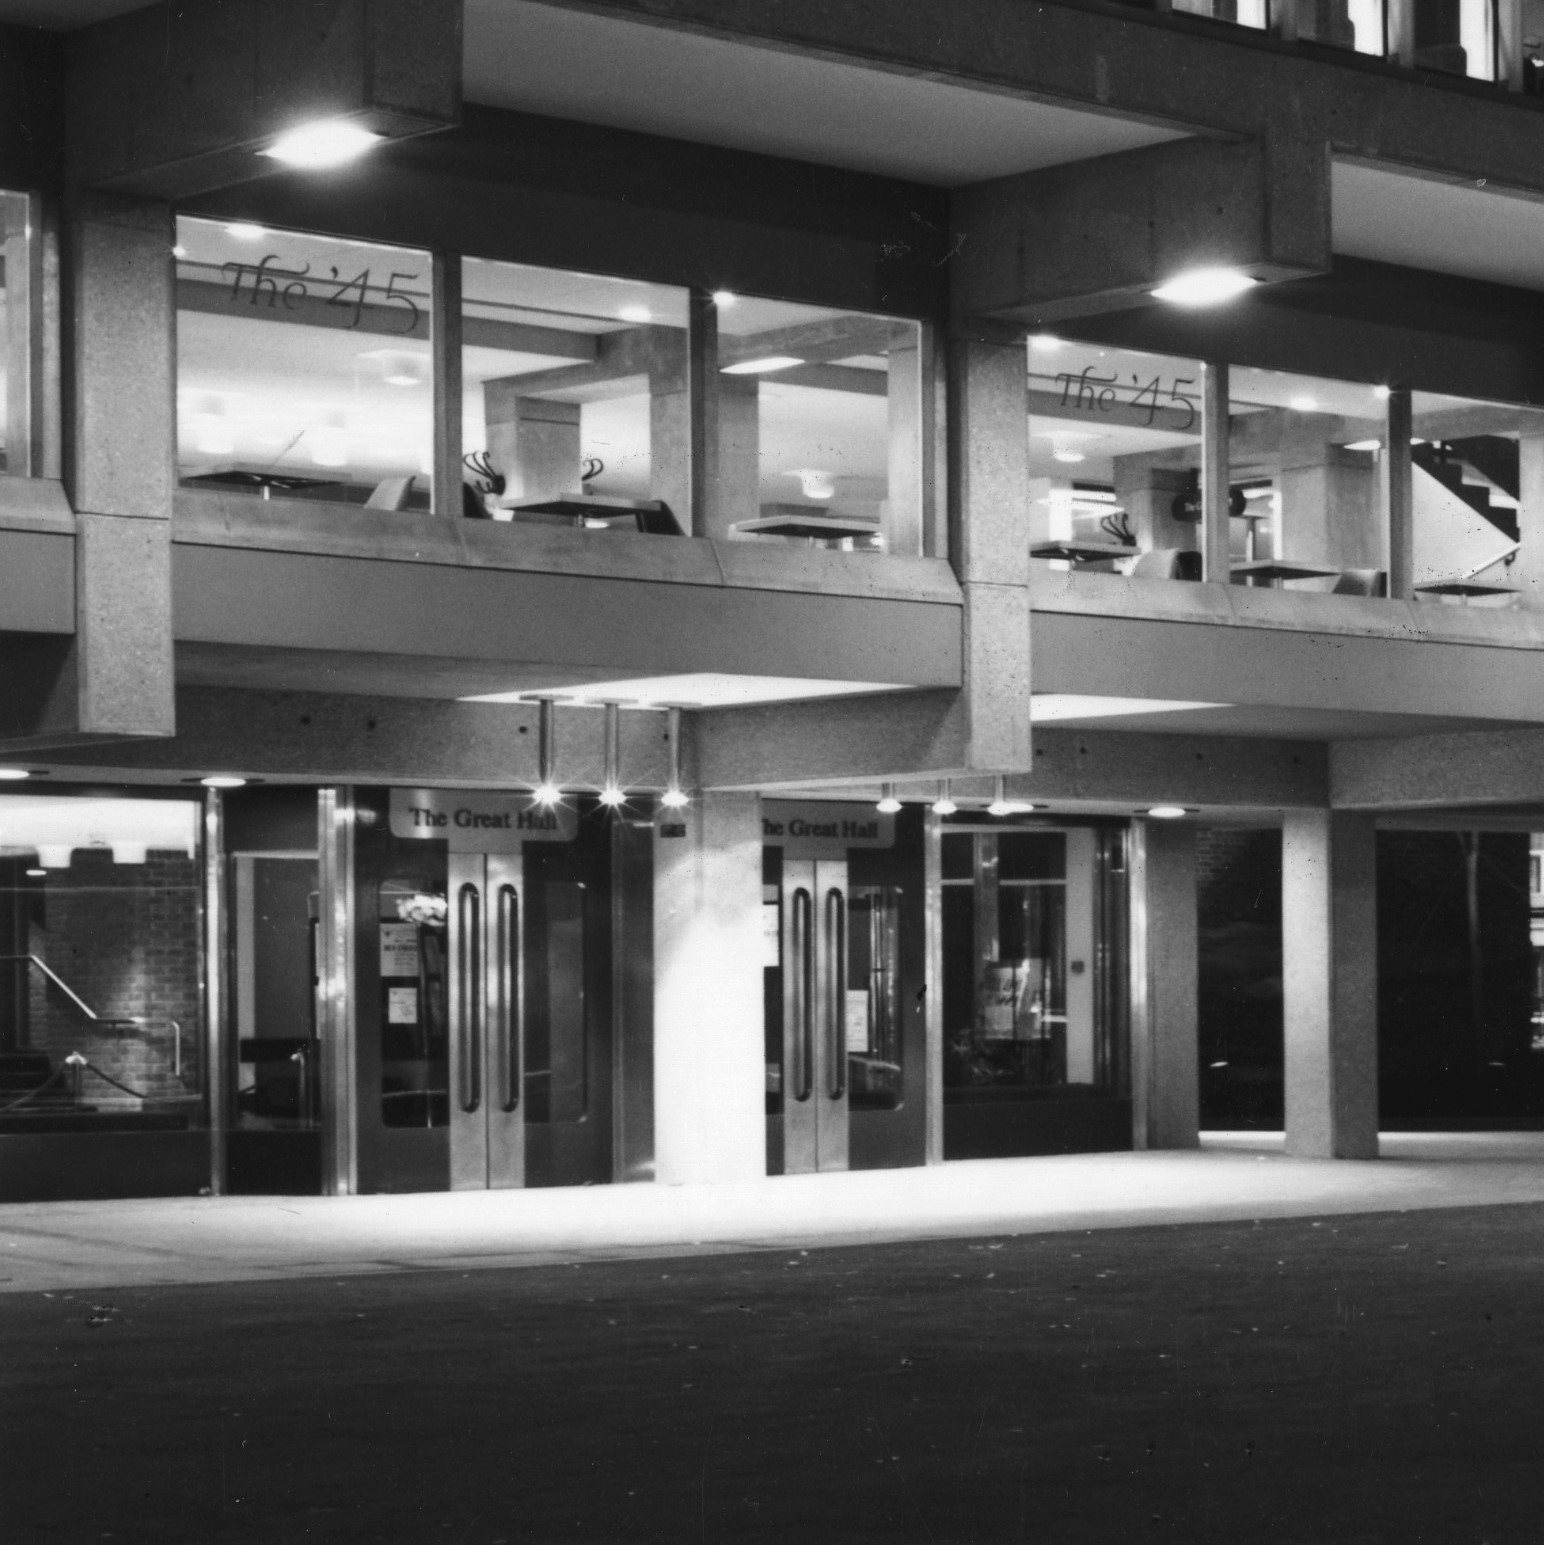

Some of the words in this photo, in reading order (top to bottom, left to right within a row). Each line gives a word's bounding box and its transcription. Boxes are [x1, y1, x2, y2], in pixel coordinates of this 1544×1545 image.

[221, 254, 310, 310] The
[1055, 365, 1118, 412] The
[408, 808, 448, 828] The
[454, 808, 511, 829] Great
[517, 809, 557, 830] Hall
[762, 818, 784, 836] he
[788, 819, 838, 838] Great
[842, 820, 879, 839] Hall
